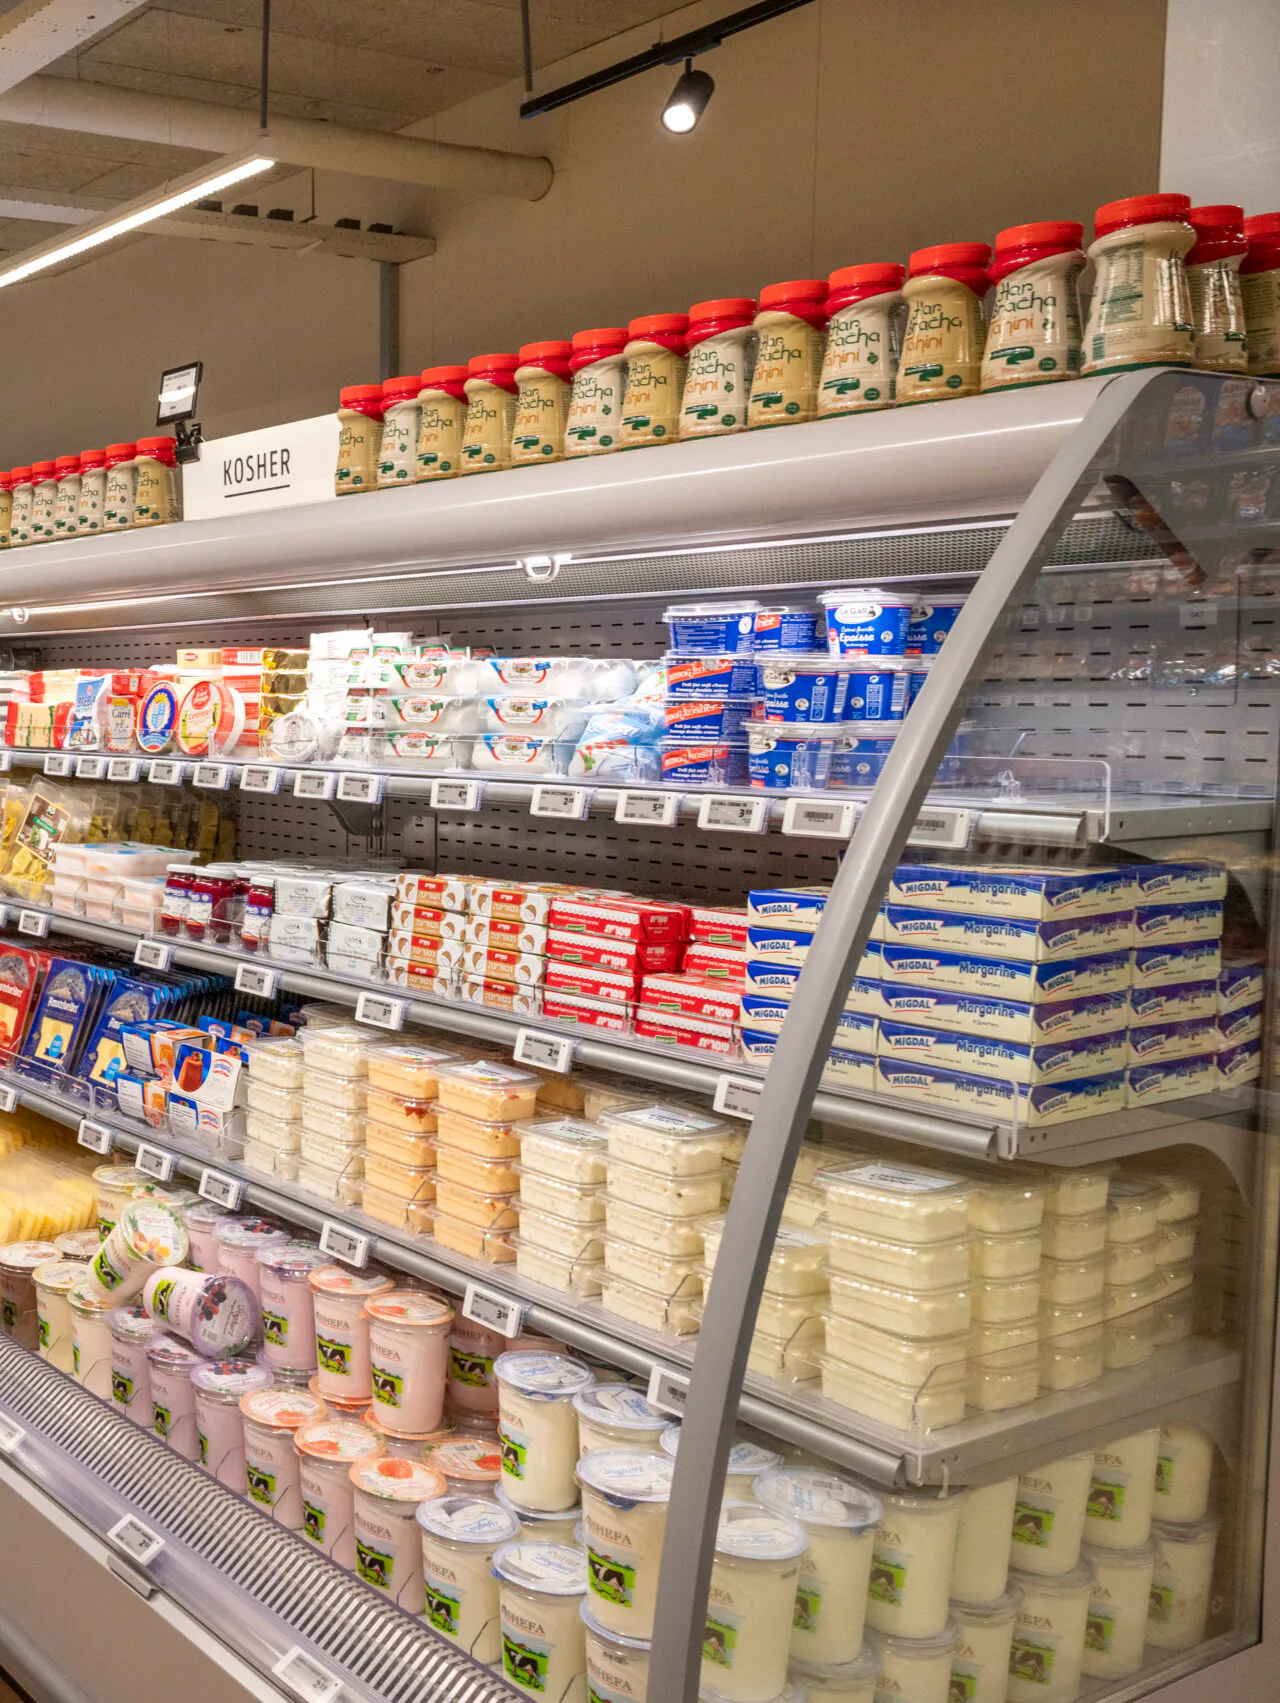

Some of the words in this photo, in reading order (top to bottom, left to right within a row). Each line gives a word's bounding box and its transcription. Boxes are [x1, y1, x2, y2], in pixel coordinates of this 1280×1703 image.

[999, 282, 1033, 301] Har
[223, 448, 291, 485] KOSHER
[906, 883, 943, 893] MIGDAL
[970, 881, 1027, 897] Margarine
[762, 904, 792, 914] MIGDAL
[901, 922, 938, 932] MIGDAL
[964, 921, 1022, 938] Margarine
[760, 941, 791, 951] MIGDAL
[897, 961, 934, 970] MIGDAL
[959, 961, 1016, 978] Margarine
[760, 976, 790, 985] MIGDAL
[754, 1010, 784, 1019] MIGDAL
[894, 999, 931, 1009] MIGDAL
[956, 1000, 1015, 1019] Margarine
[754, 1045, 774, 1054] MIGD
[894, 1037, 930, 1047] MIGDAL
[956, 1040, 1015, 1060] Margarine
[892, 1076, 929, 1086] MIGDAL
[954, 1079, 1012, 1100] Margarine
